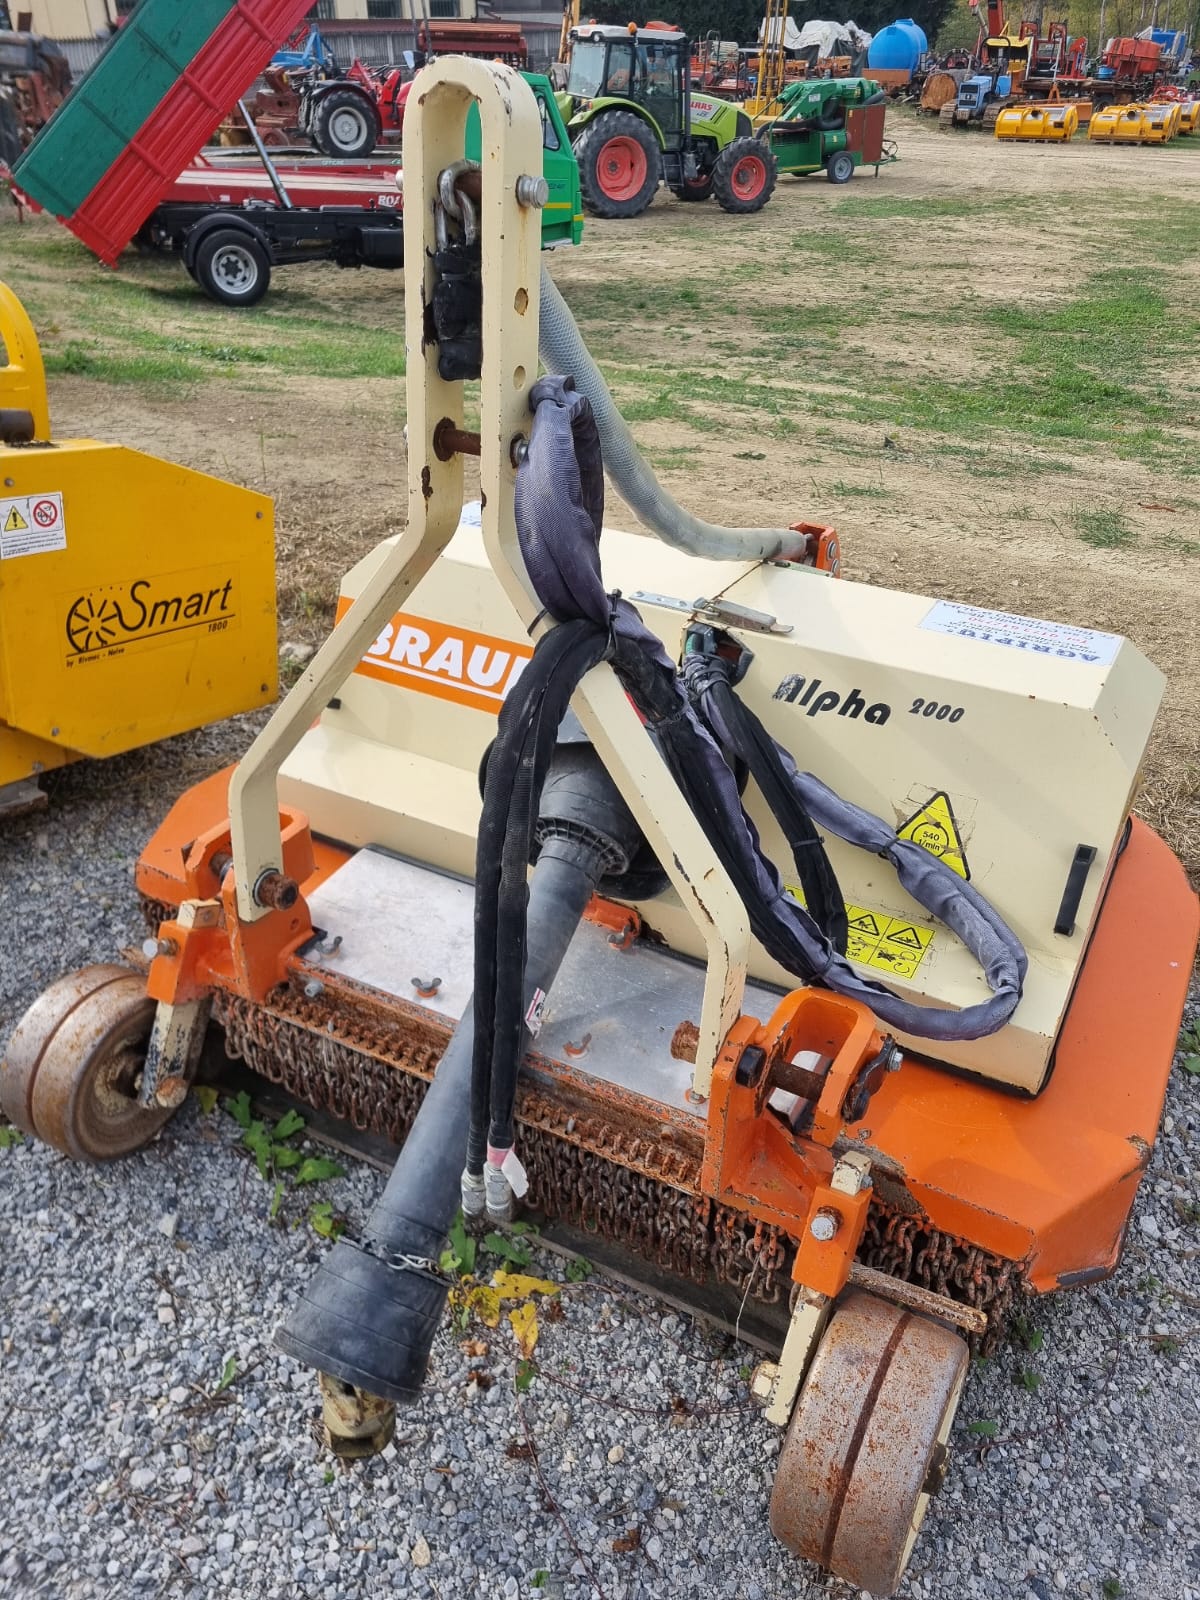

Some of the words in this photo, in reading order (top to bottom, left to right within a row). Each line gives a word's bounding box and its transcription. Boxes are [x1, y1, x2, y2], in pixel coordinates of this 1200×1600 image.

[689, 101, 713, 111] LAAS
[113, 580, 232, 632] Smart
[208, 620, 228, 633] 1800
[772, 674, 891, 725] Alpha
[908, 698, 965, 723] 2000
[922, 831, 940, 841] 540
